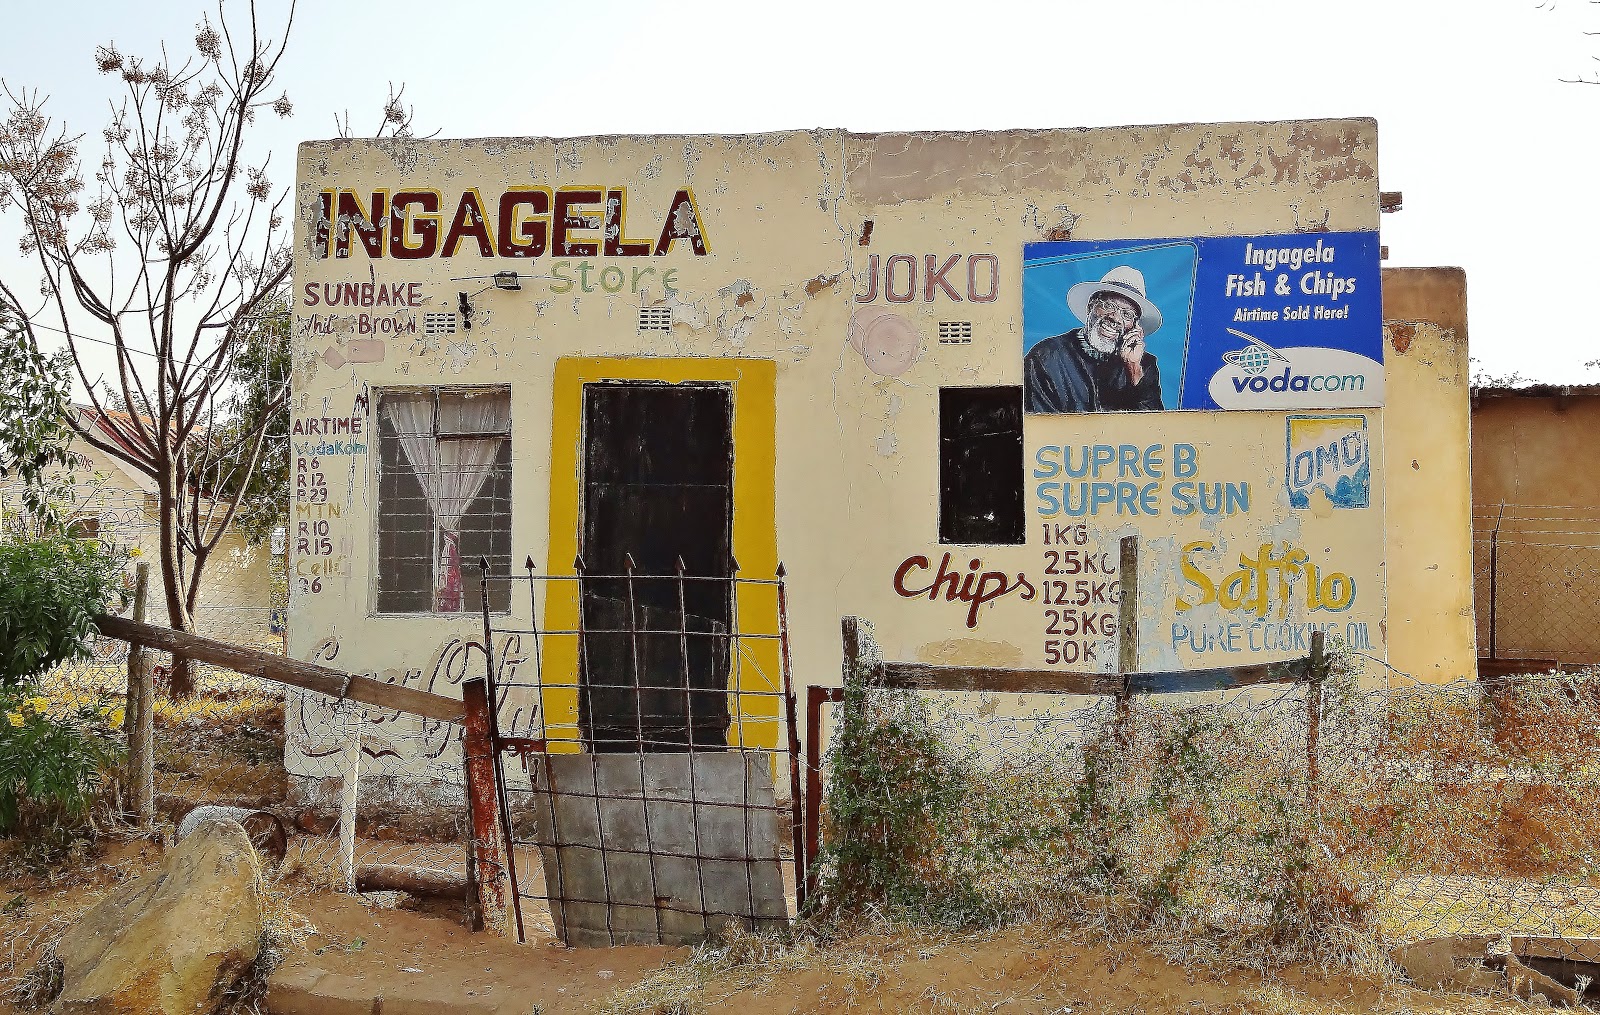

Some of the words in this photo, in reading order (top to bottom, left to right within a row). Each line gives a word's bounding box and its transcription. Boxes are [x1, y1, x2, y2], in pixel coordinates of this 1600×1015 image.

[315, 186, 712, 260] INGAGELA
[1245, 240, 1334, 271] Ingagela
[854, 253, 999, 304] JOKO
[1225, 273, 1265, 297] Fish
[1274, 274, 1291, 295] &
[1300, 271, 1357, 301] Chips
[303, 282, 422, 307] SUNBAKE
[1233, 307, 1279, 322] Airtime
[1283, 305, 1309, 321] Sold
[1314, 305, 1349, 320] Here!
[1231, 366, 1365, 394] vodacom
[292, 417, 362, 436] AIRTIME
[1034, 443, 1166, 480] SUPRE
[1173, 443, 1200, 479] B
[1293, 431, 1362, 489] OMO
[295, 502, 342, 519] MTN
[1036, 481, 1164, 517] SUPRE
[1170, 481, 1252, 518] SUN
[1042, 523, 1088, 546] 1KG
[893, 551, 1037, 629] Chips
[1044, 609, 1117, 637] 25KG
[1346, 621, 1377, 651] OIL
[1044, 640, 1116, 665] 50K
